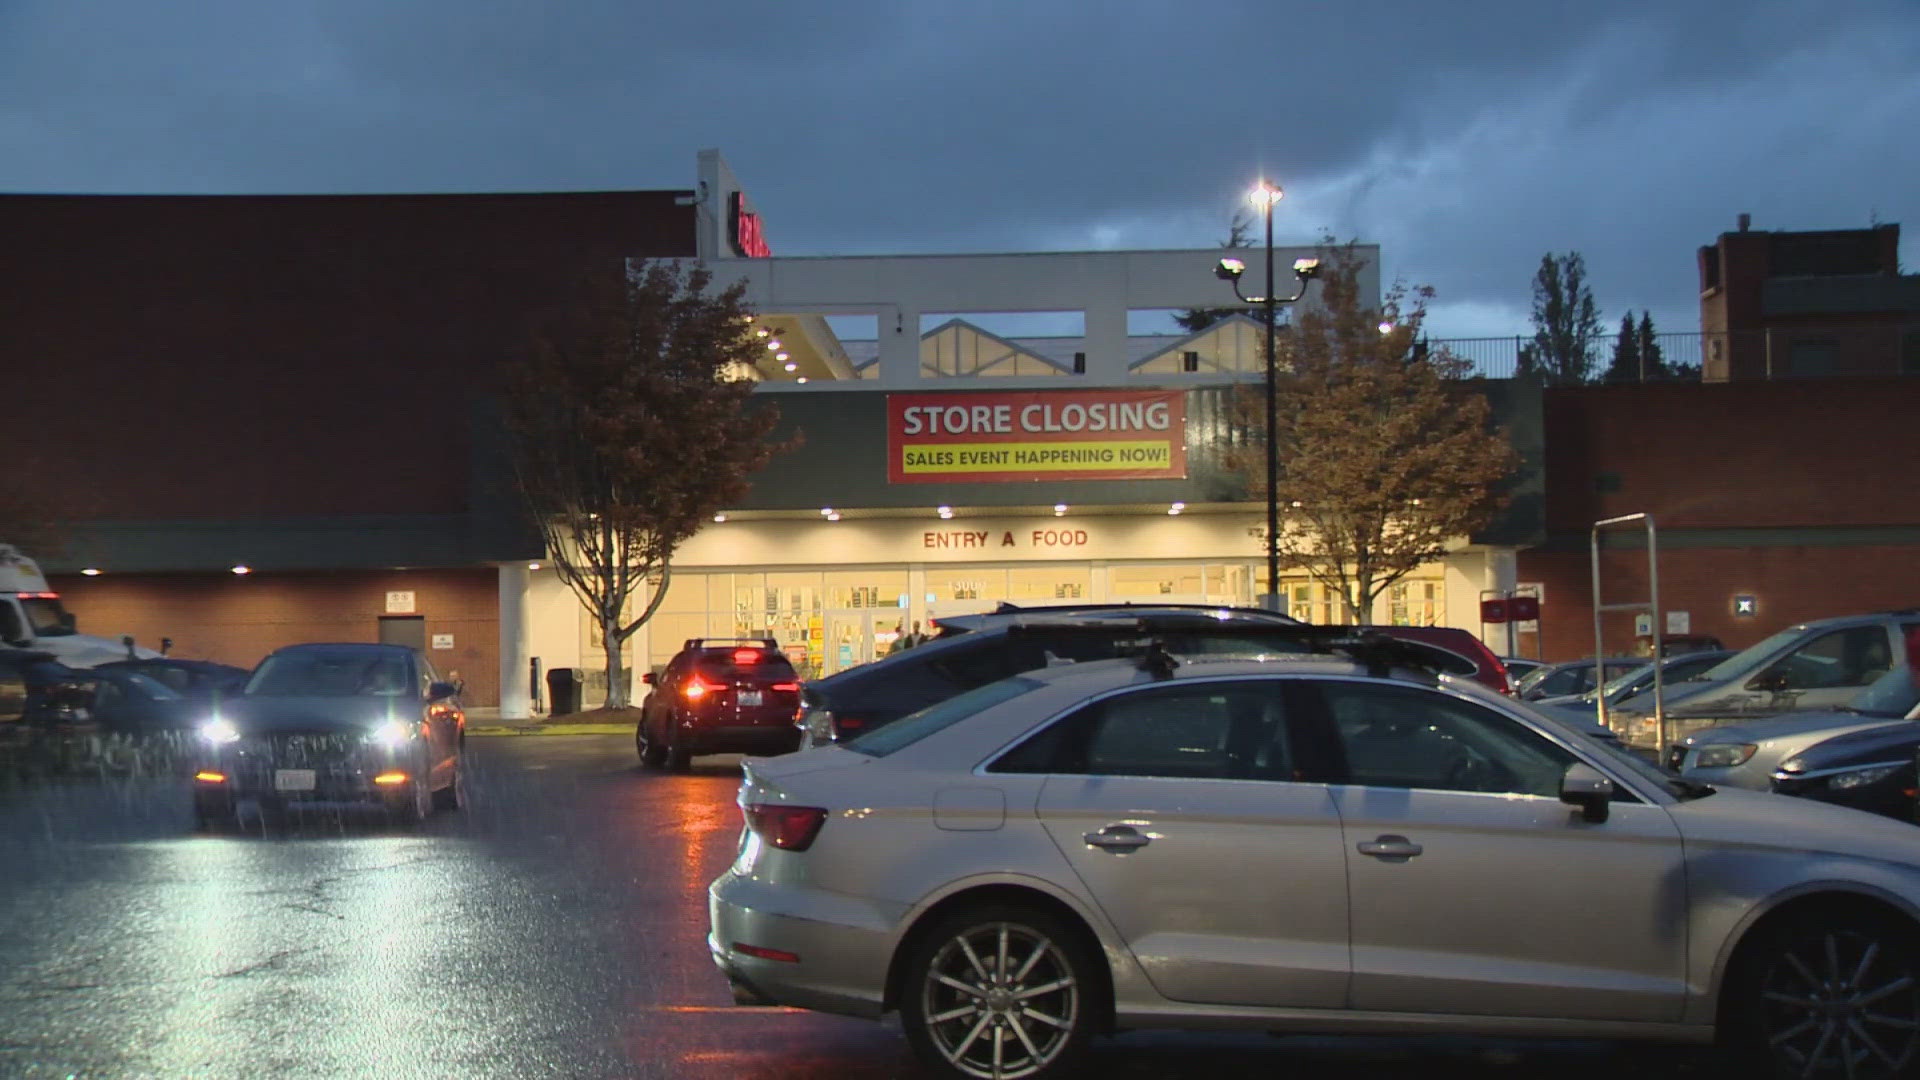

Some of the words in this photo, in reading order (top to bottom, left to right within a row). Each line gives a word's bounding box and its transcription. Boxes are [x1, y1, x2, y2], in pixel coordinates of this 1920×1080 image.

[903, 405, 1013, 434] STORE
[1020, 402, 1170, 432] CLOSING
[905, 451, 953, 466] SALES
[959, 450, 1009, 465] EVENT
[1015, 448, 1113, 463] HAPPENING
[1119, 447, 1168, 462] NOW!
[924, 531, 989, 548] ENTRY
[1001, 531, 1015, 547] A
[1032, 530, 1088, 546] FOOD
